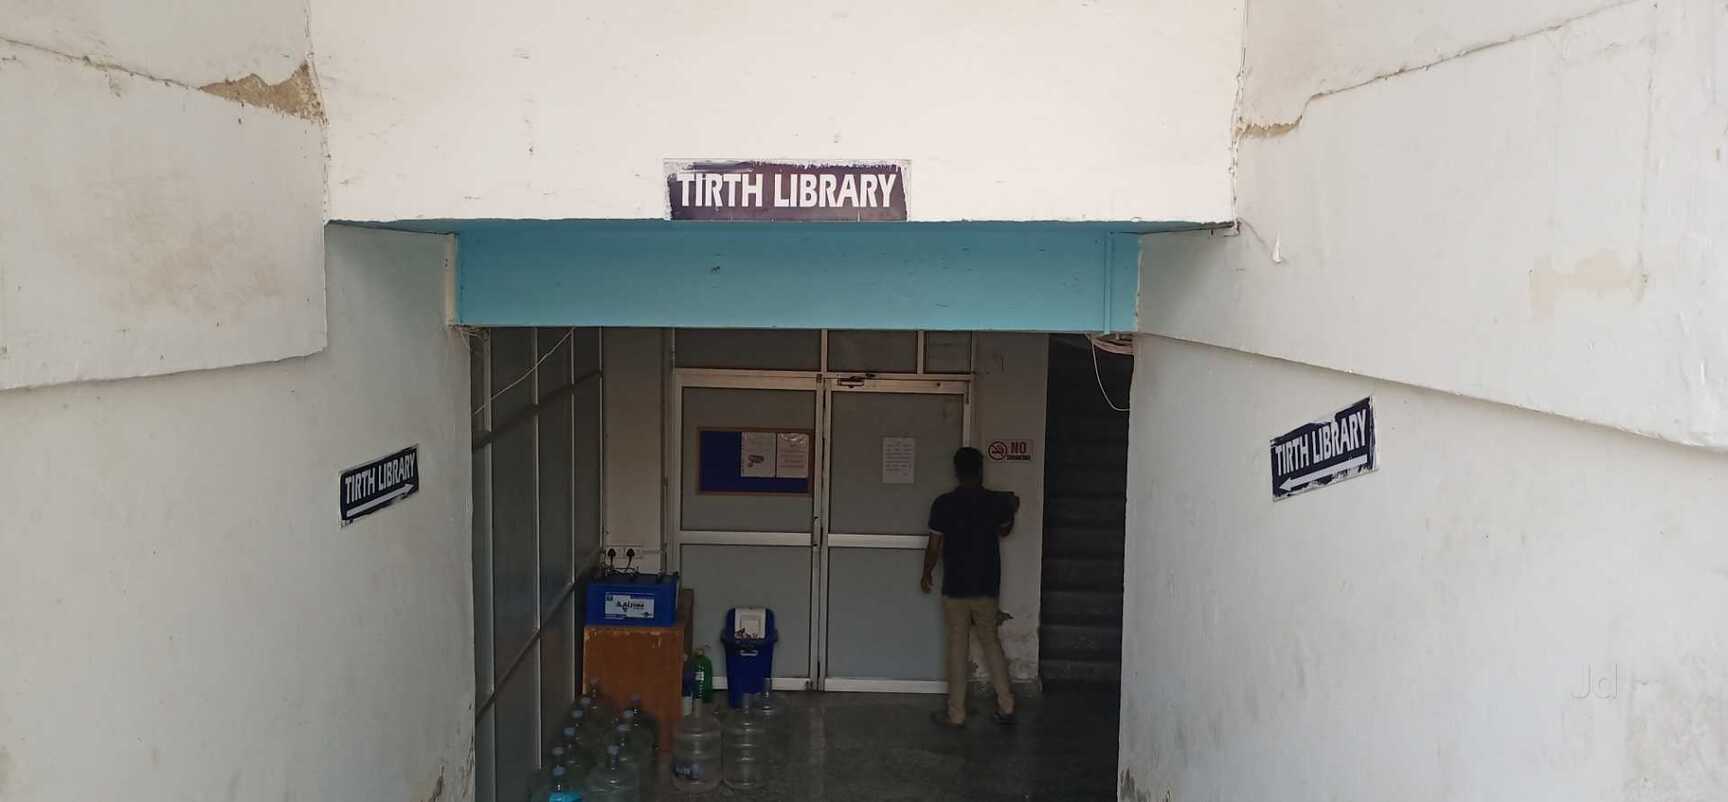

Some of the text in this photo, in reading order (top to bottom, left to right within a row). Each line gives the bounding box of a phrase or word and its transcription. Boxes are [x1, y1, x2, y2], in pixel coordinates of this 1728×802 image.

[677, 173, 897, 208] TIRTH LIBRARY
[1010, 441, 1026, 454] NO
[1275, 409, 1367, 477] TIRTH LIBRARY
[345, 452, 416, 505] TIRTH LIBRARY
